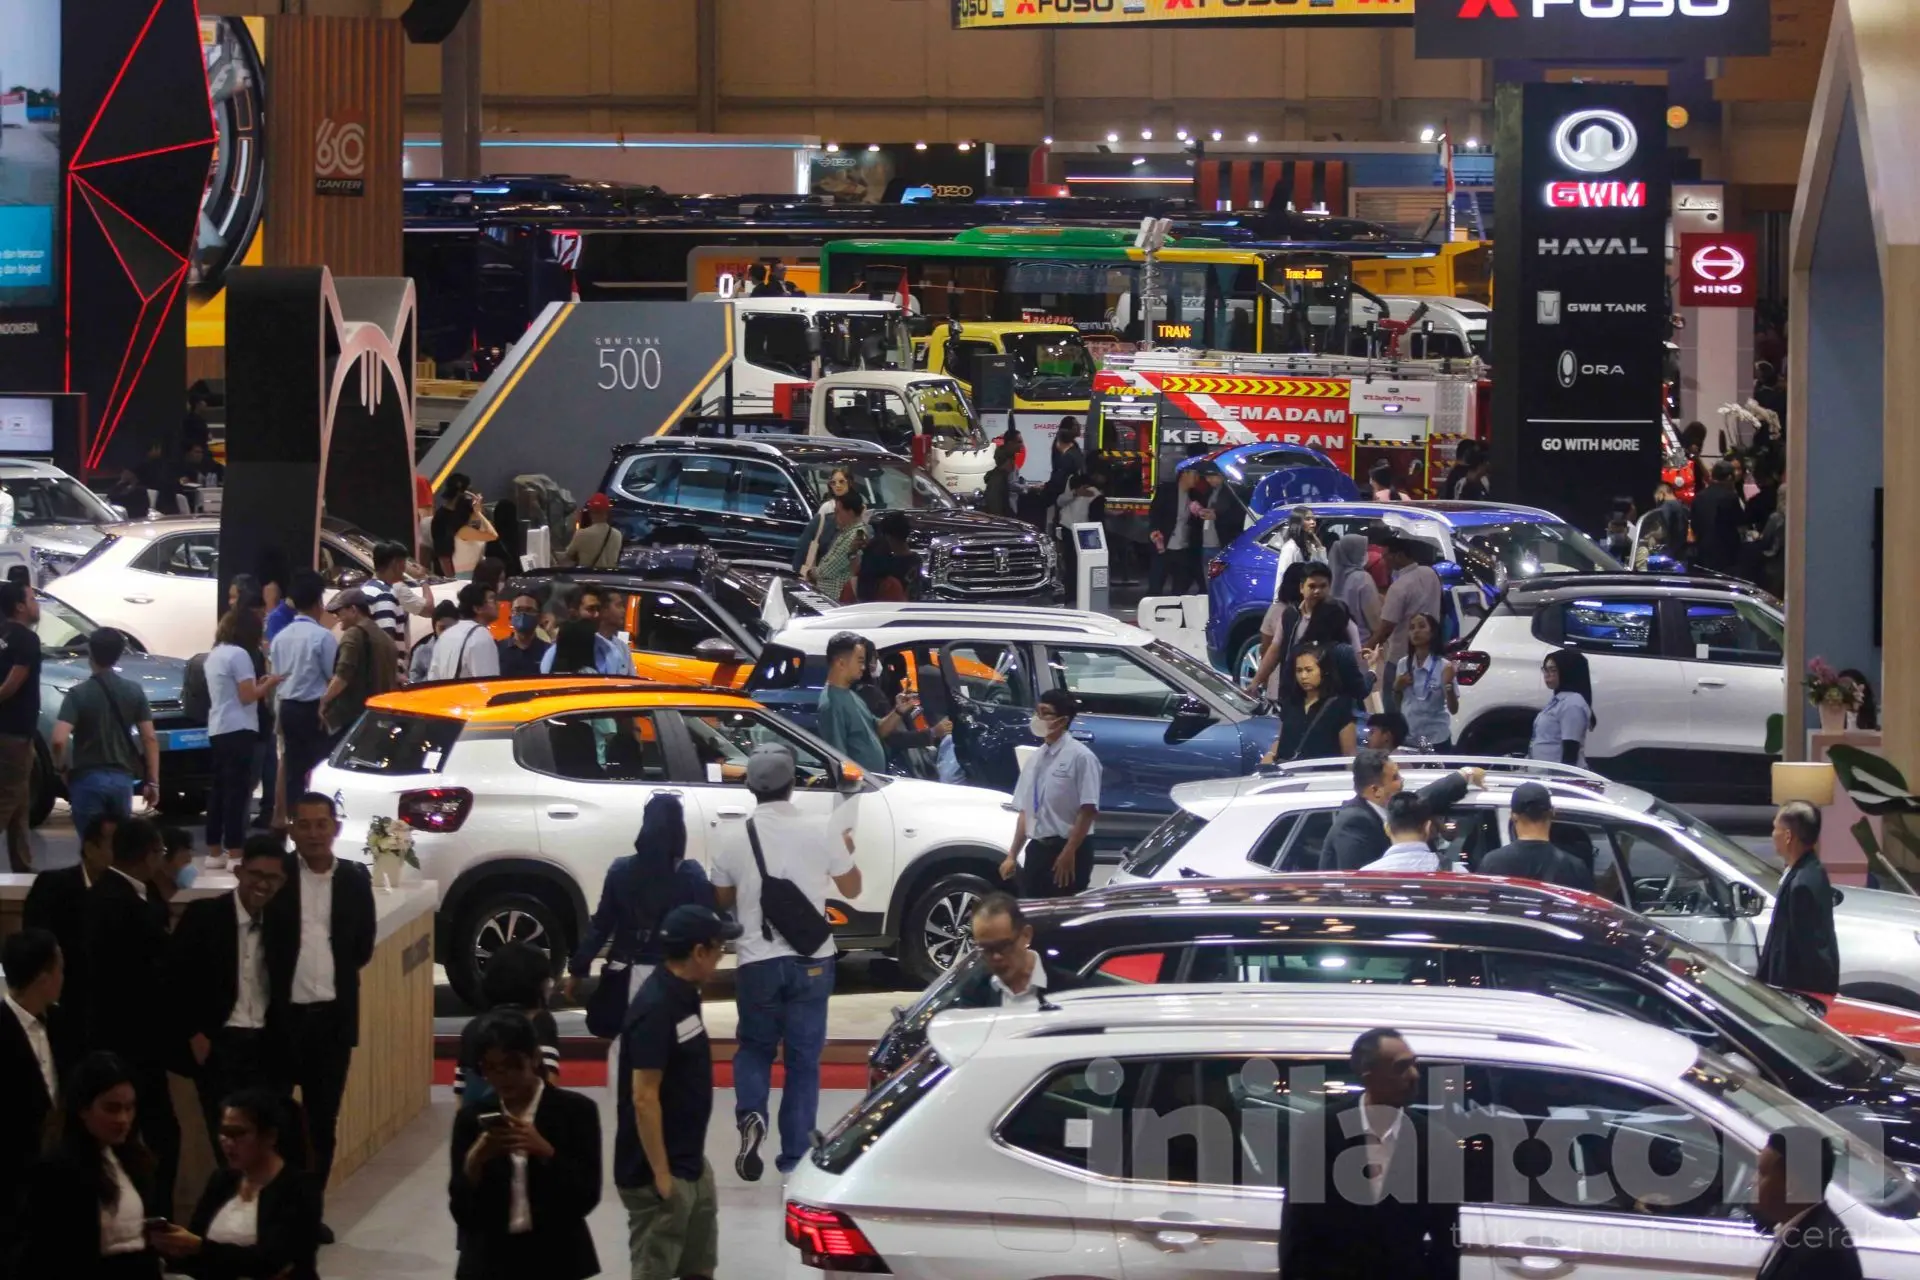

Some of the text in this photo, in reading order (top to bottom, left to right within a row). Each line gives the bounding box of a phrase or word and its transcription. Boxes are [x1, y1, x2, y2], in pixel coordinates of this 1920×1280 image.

[1546, 181, 1647, 208] GWM
[1537, 237, 1649, 255] HAVAL
[1693, 284, 1742, 294] HINO
[1567, 302, 1647, 312] GWM TANK
[598, 347, 662, 390] 500
[1581, 364, 1625, 376] ORA
[1205, 404, 1346, 424] PEMADAM
[1541, 438, 1640, 451] GO WITH MORE
